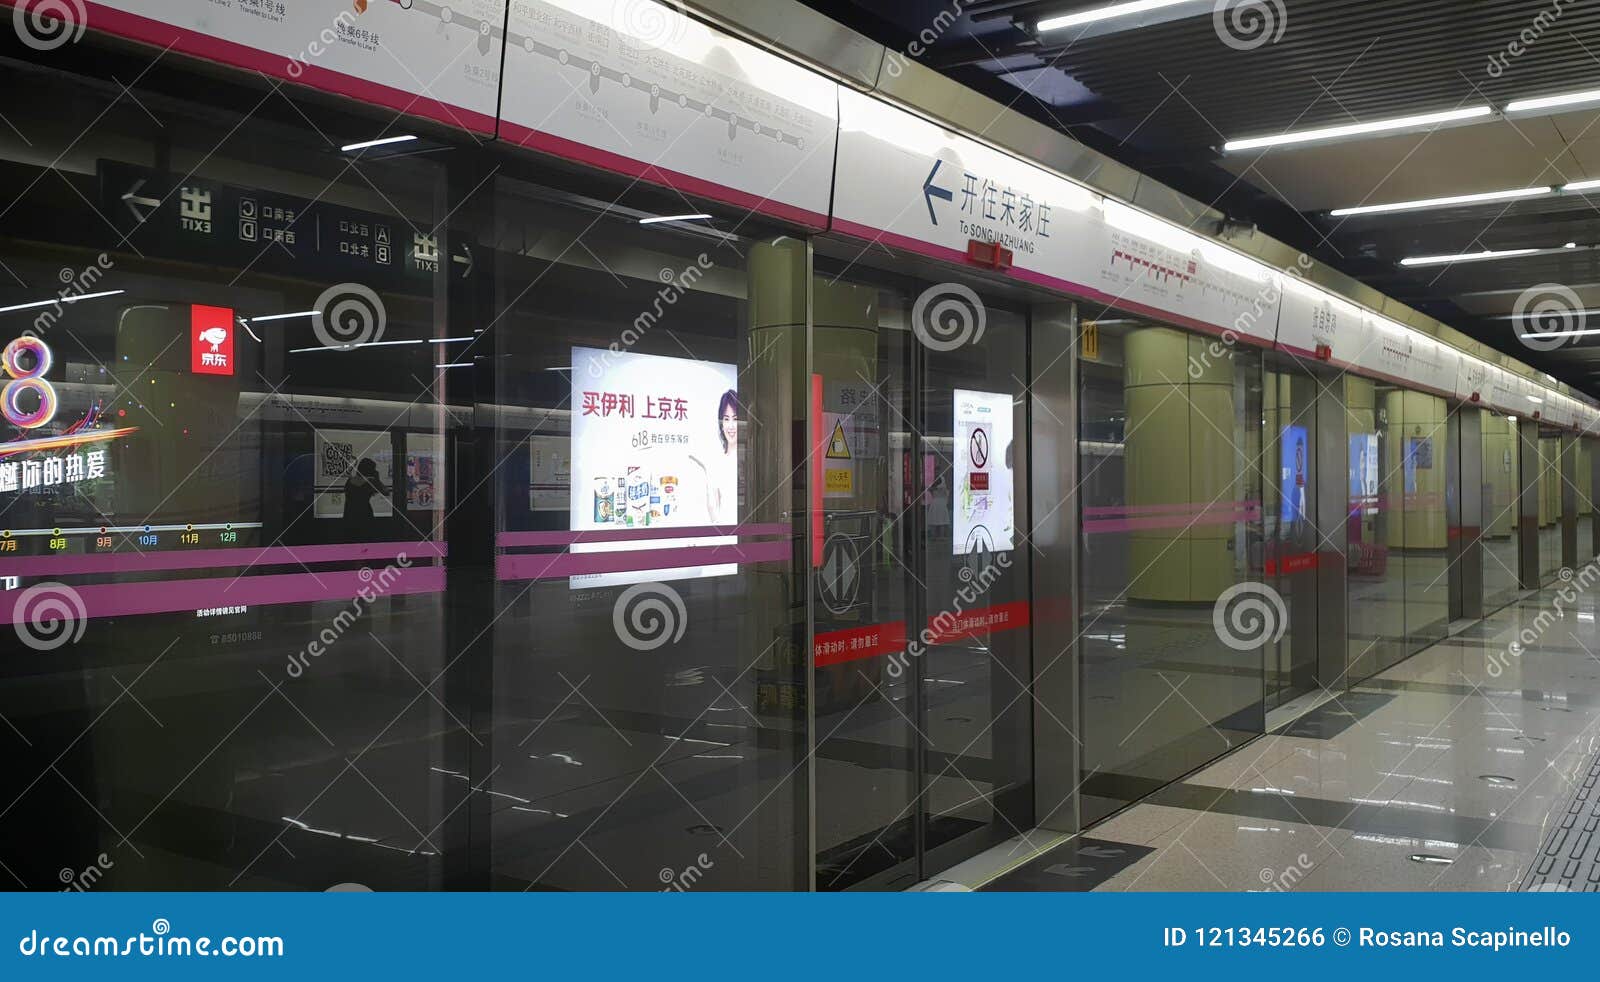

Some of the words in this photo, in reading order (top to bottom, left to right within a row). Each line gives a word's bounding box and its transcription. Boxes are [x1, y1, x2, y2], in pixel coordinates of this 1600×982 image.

[961, 172, 1051, 238] 开往宋家庄
[960, 220, 969, 234] To
[970, 223, 1035, 254] SONGJIAZHUANG
[201, 353, 228, 367] 京东
[582, 391, 635, 418] 买伊利
[641, 394, 689, 421] 上京东
[631, 430, 649, 448] 618
[49, 538, 66, 549] 8月
[96, 537, 112, 548] 9月
[138, 535, 158, 546] 10月
[180, 533, 199, 544] 11月
[219, 532, 237, 543] 12月
